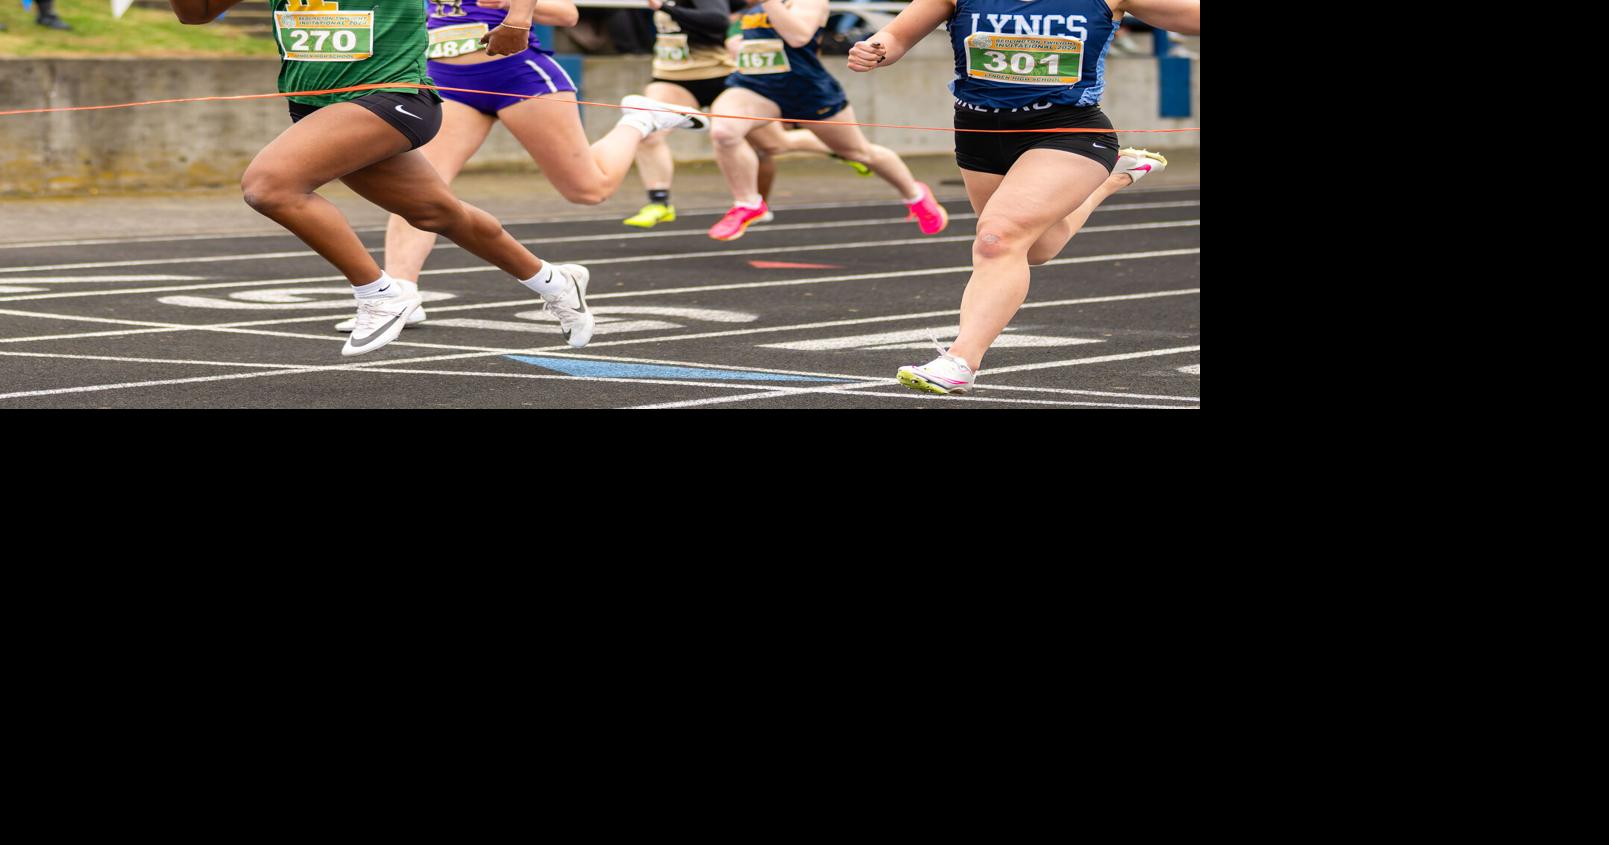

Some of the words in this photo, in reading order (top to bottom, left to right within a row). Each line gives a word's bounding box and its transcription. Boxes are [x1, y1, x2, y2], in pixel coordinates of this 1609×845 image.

[971, 13, 1088, 41] LYNCS
[290, 30, 356, 51] 270
[983, 51, 1059, 75] 301
